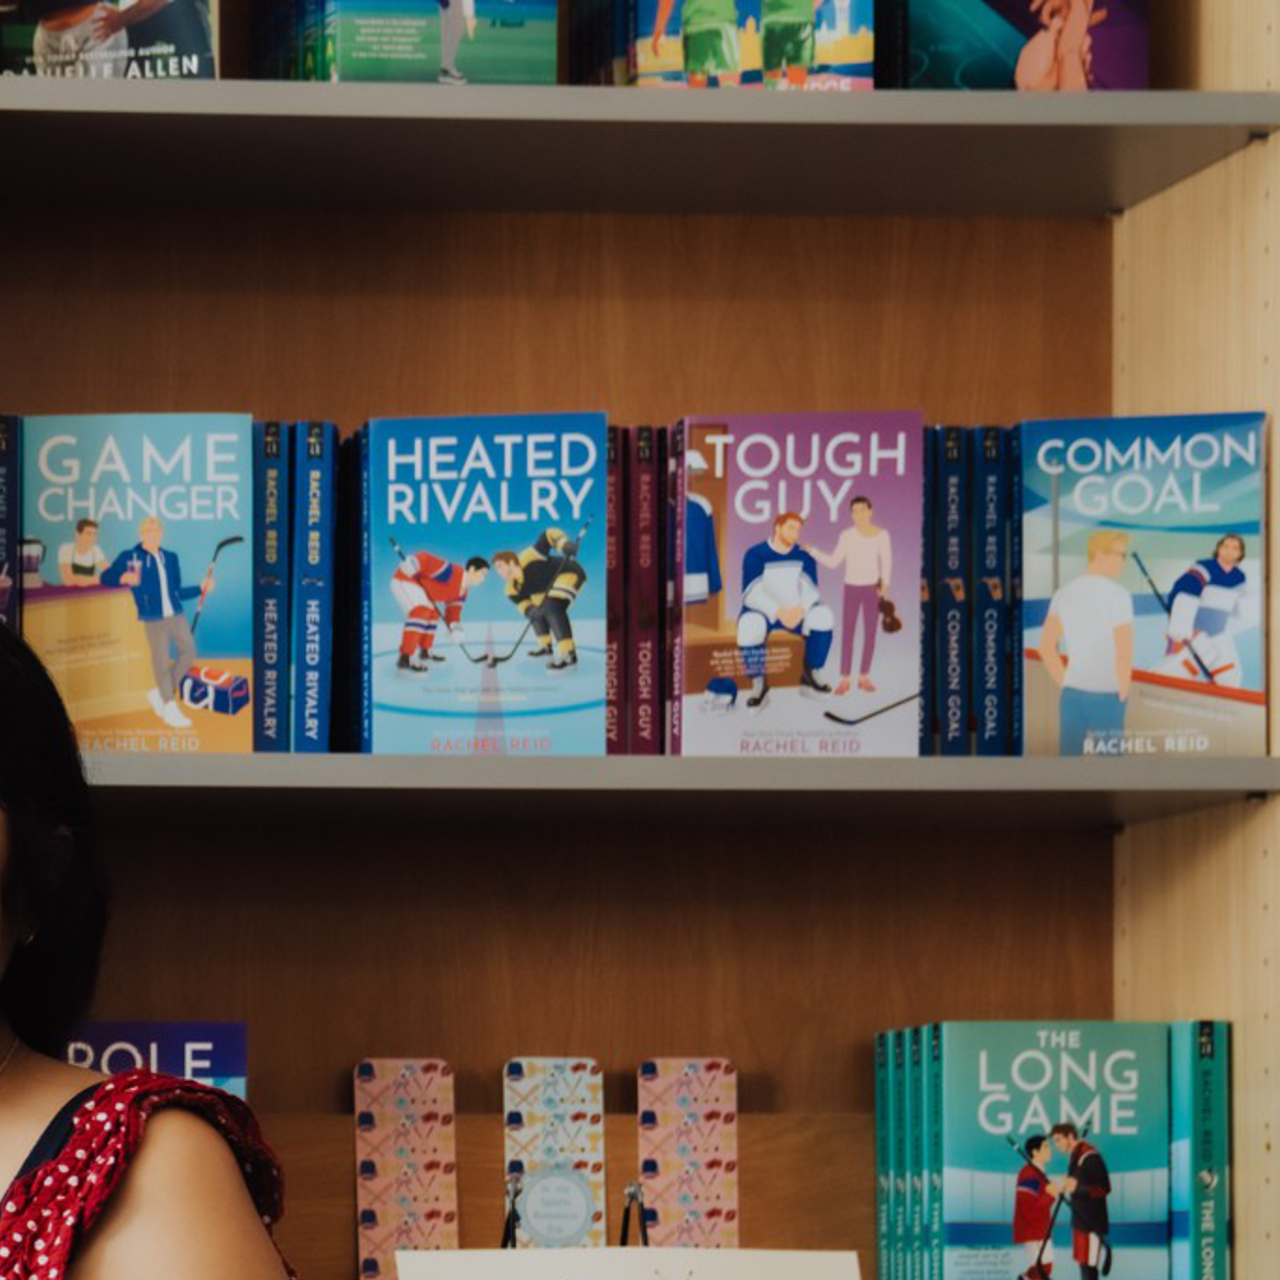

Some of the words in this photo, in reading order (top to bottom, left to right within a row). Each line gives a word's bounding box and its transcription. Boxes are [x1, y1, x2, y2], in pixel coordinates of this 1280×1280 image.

[126, 54, 198, 78] ALLEN
[38, 433, 239, 484] GAME
[388, 433, 597, 481] HEATED
[705, 430, 907, 479] TOUGH
[1037, 430, 1256, 476] COMMON
[37, 486, 241, 522] CHANGER
[307, 469, 321, 526] RACHEL
[387, 479, 594, 525] RIVALRY
[734, 479, 854, 523] GUY
[1072, 471, 1221, 516] GOAL
[307, 530, 321, 565] REID
[264, 598, 278, 666] HEATED
[306, 599, 320, 667] HEATED
[948, 608, 961, 692] COMMON
[984, 608, 998, 690] COMMON
[639, 641, 653, 701] TOUGH
[263, 669, 278, 740] RIVALRY
[305, 670, 319, 741] RIVALRY
[638, 703, 652, 741] GUY
[947, 696, 961, 742] GOAL
[984, 694, 998, 740] GOAL
[1083, 738, 1157, 755] RACHEL
[1164, 734, 1210, 752] REID
[1037, 1030, 1083, 1049] THE
[978, 1049, 1140, 1093] LONG
[977, 1092, 1140, 1135] GAME
[1201, 1200, 1215, 1232] THE
